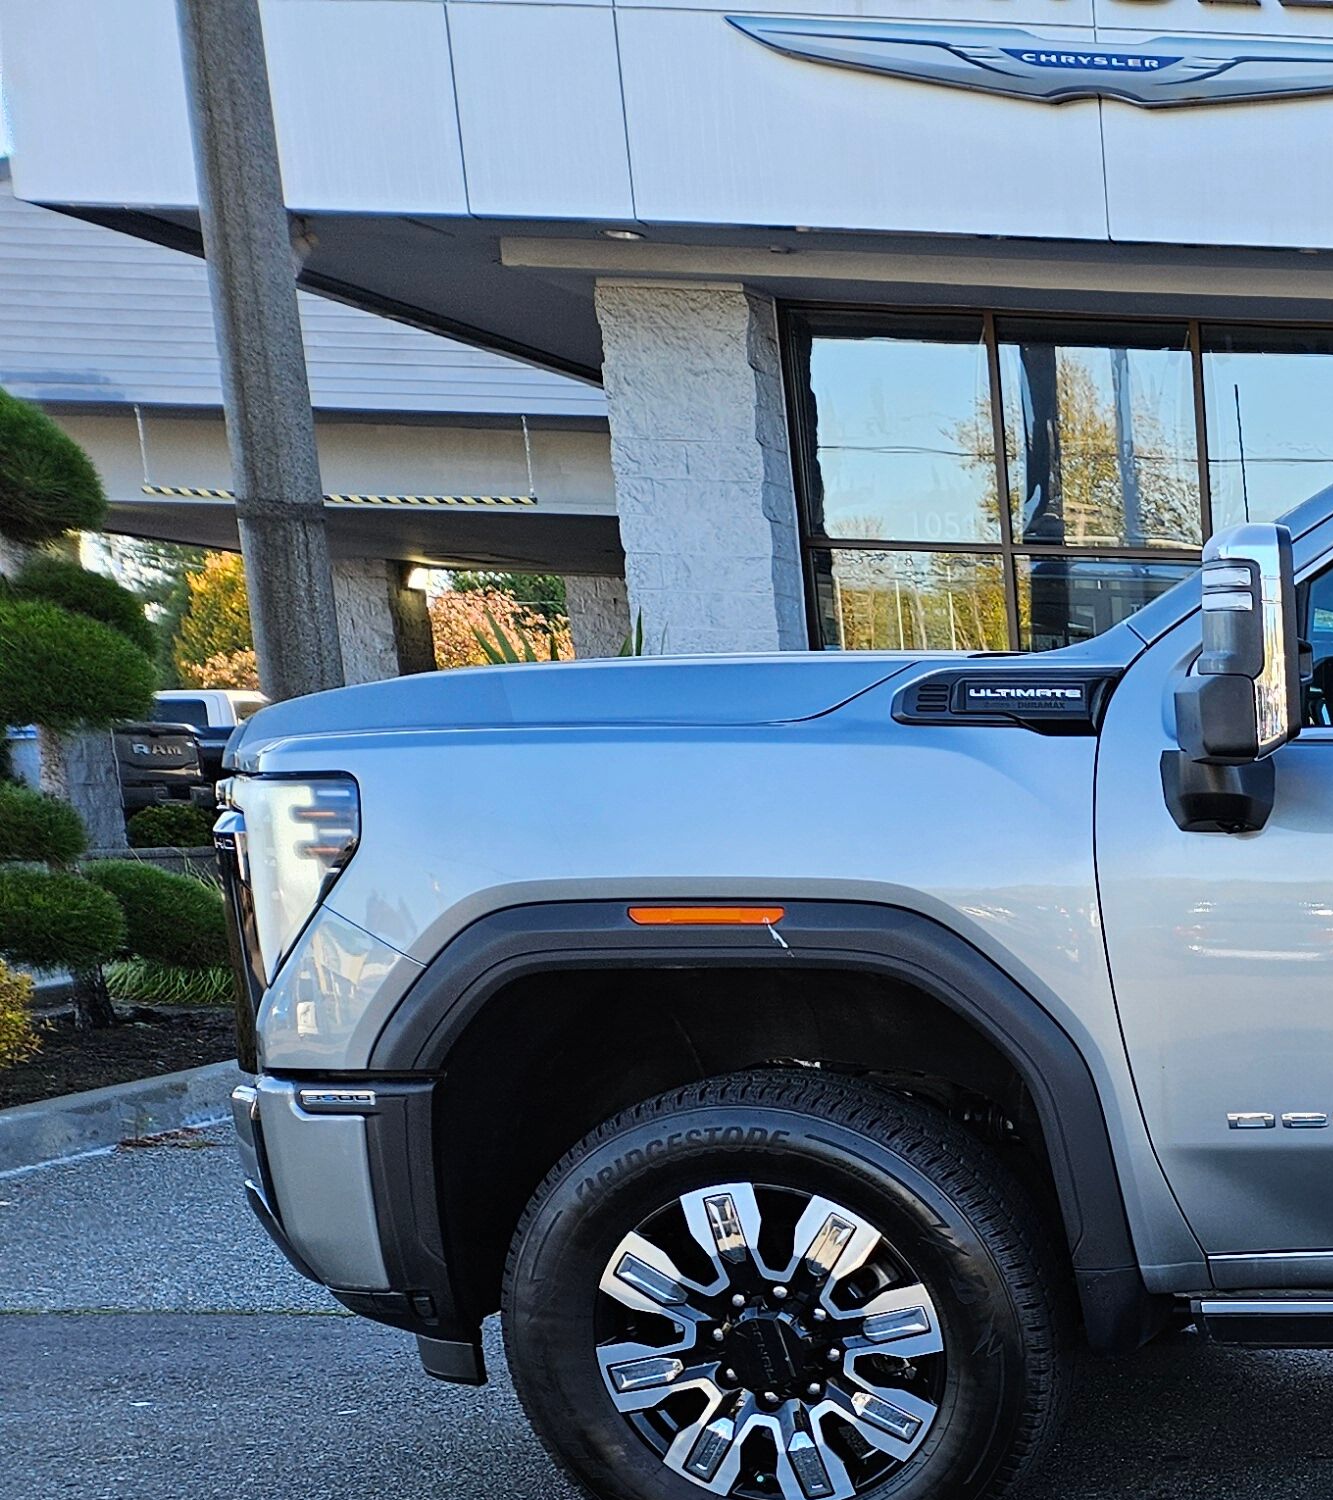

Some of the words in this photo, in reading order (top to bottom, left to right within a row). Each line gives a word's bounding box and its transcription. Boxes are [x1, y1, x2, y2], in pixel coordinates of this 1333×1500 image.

[1021, 52, 1159, 68] CHRYSLER
[969, 688, 1082, 698] ULTIMATE
[1017, 701, 1066, 709] DURAMAX
[132, 742, 183, 756] RAM
[576, 1126, 790, 1200] BRIDGESTONE
